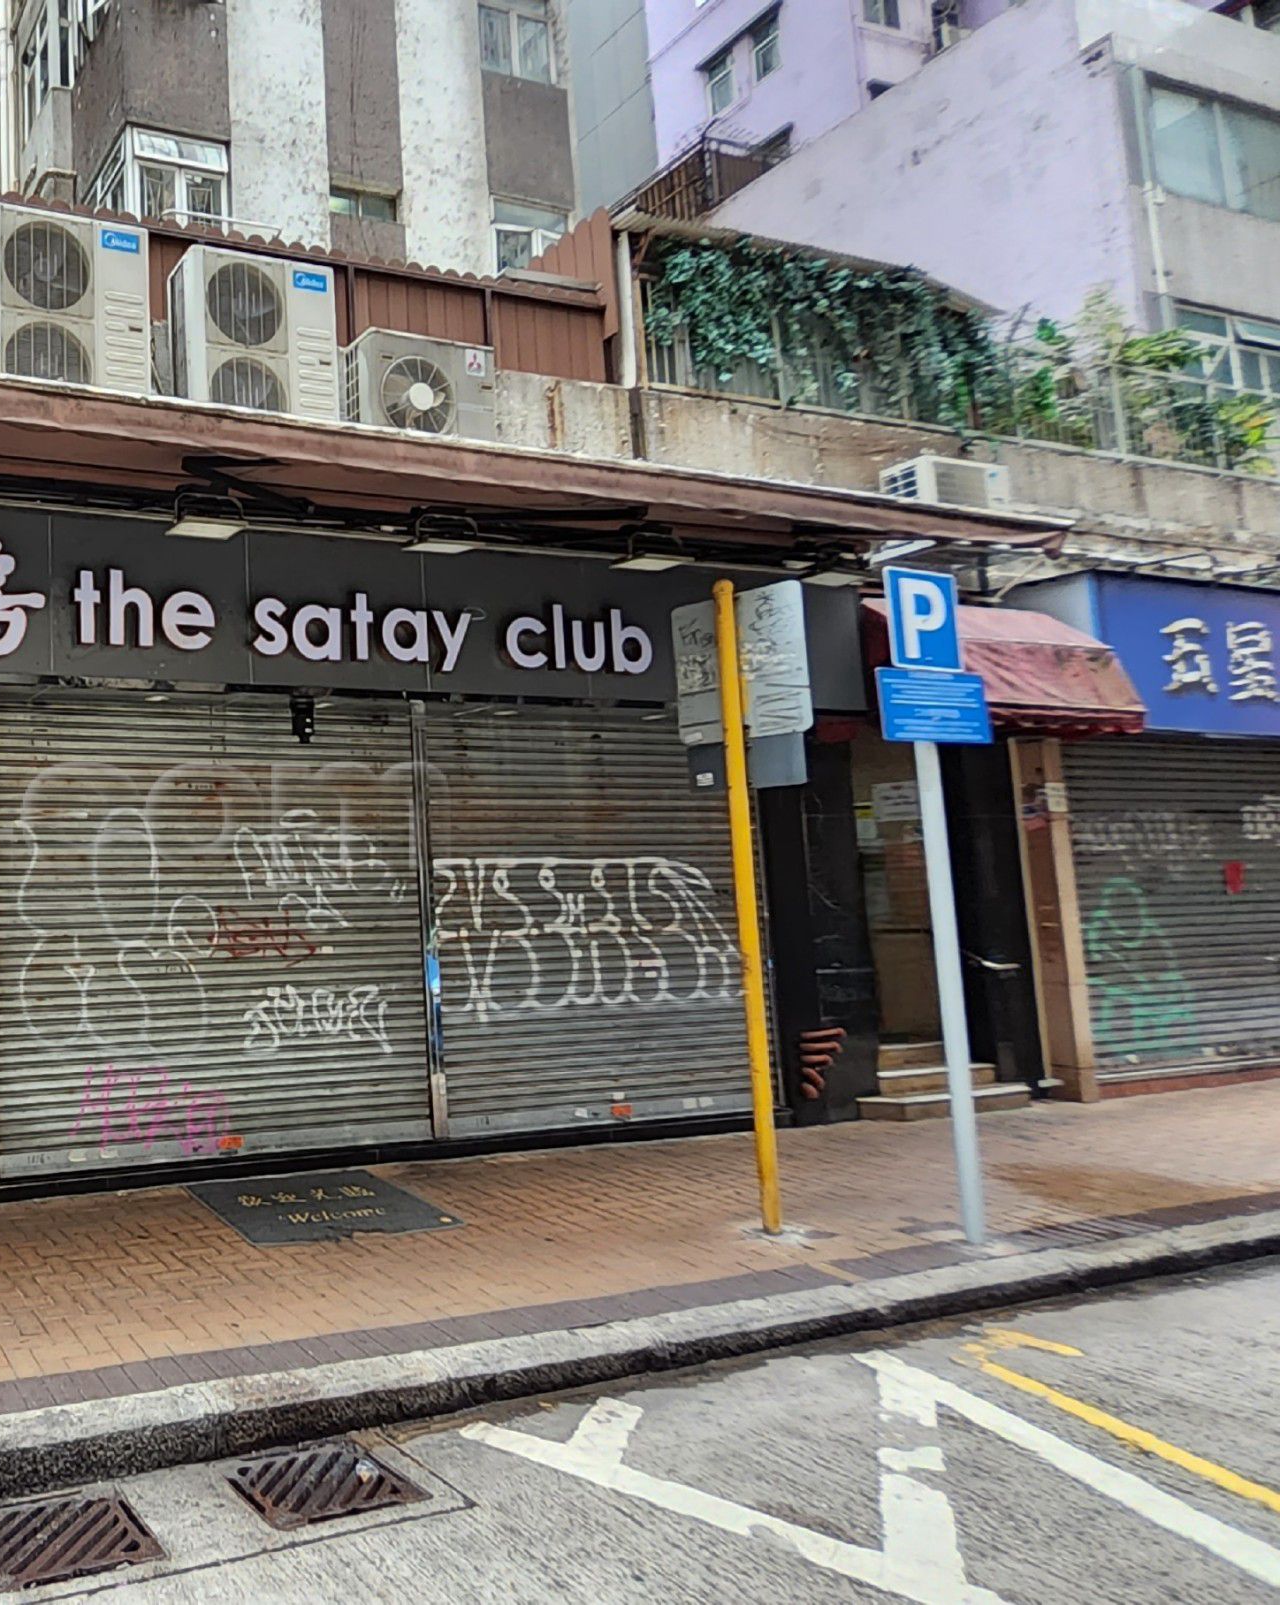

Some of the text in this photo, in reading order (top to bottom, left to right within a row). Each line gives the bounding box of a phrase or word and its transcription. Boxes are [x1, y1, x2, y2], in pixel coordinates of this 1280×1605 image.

[73, 569, 215, 650] the
[253, 592, 472, 672] satay
[505, 603, 653, 675] club
[898, 577, 947, 659] P
[287, 1206, 386, 1224] Welcome
